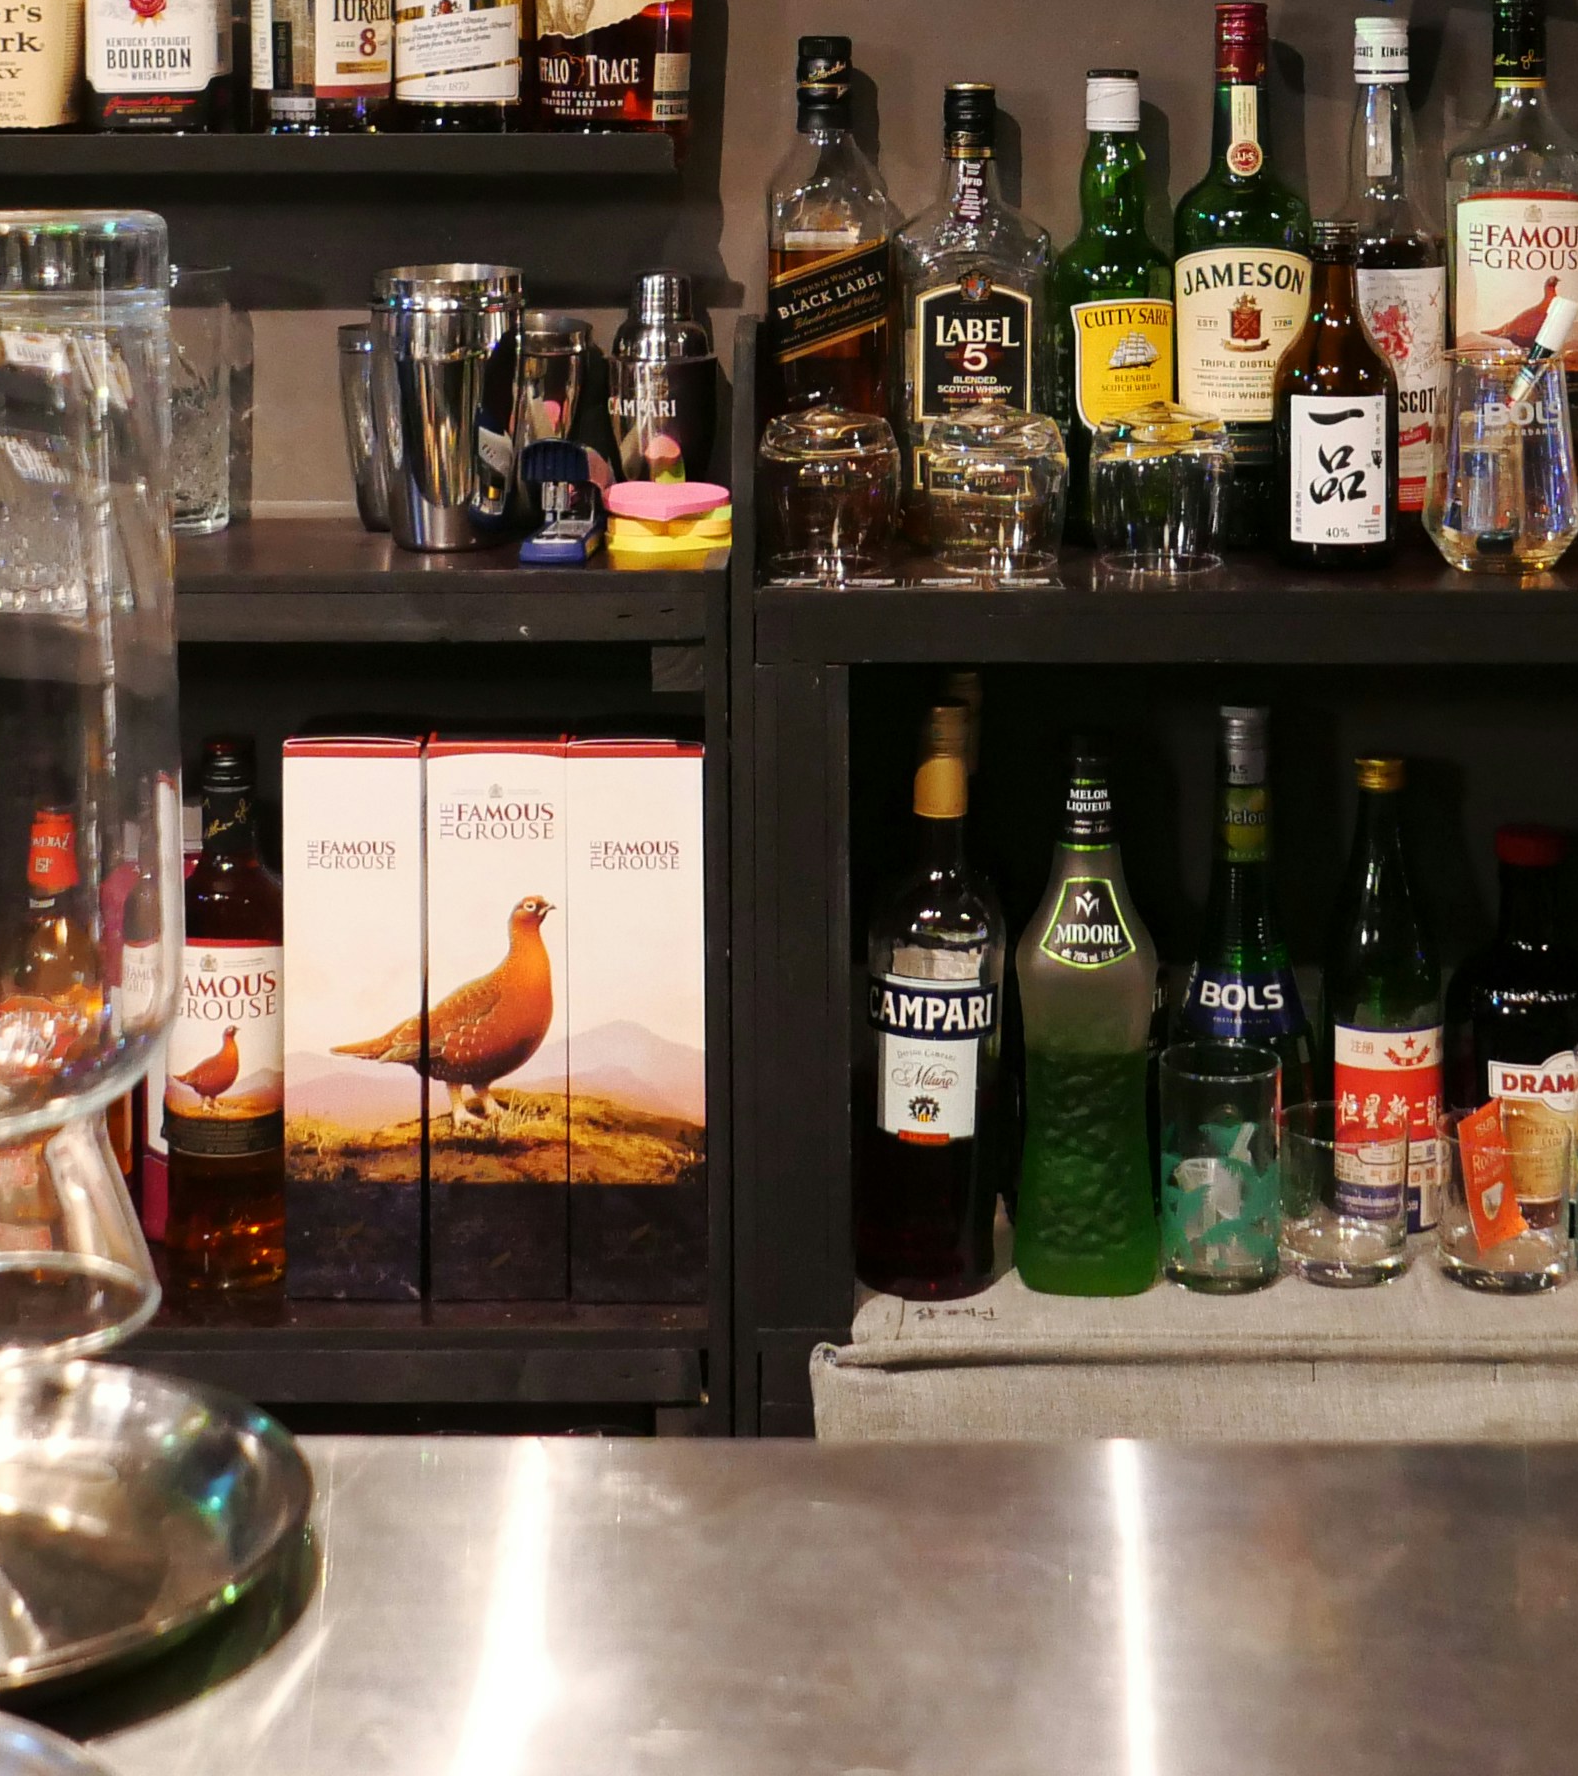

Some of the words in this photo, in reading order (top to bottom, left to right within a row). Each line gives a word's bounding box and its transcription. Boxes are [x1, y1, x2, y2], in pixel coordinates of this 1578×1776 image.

[106, 37, 148, 47] KENTUCKY
[150, 36, 192, 47] STRAIGHT
[359, 28, 377, 57] 8
[106, 48, 192, 69] BOURBON
[131, 71, 169, 81] WHISKEY
[586, 55, 640, 87] TRACE
[551, 90, 597, 99] KENTUCKY
[554, 108, 594, 116] WHISKEY
[576, 100, 624, 108] BOURBON
[1468, 223, 1484, 266] THE
[830, 265, 864, 287] WALKER
[1183, 261, 1306, 296] JAMESON
[777, 289, 837, 320] BLACK
[836, 271, 886, 298] LABEL
[1083, 309, 1134, 329] CUTTY
[1137, 308, 1170, 329] SARK
[935, 315, 1021, 347] LABEL
[962, 343, 989, 372] 5
[1200, 359, 1236, 368] TRIPLE
[952, 375, 998, 384] BLENDED
[1114, 374, 1152, 383] BLENDED
[937, 384, 974, 394] SCOTCH
[974, 384, 1013, 394] WHISKY
[1207, 391, 1236, 400] IRISH
[606, 397, 677, 420] CAMPARI
[1325, 527, 1351, 539] 40%
[1069, 788, 1108, 800] MELON
[1066, 800, 1112, 812] LIQUEUR
[440, 803, 455, 839] THE
[457, 802, 555, 822] FAMOUS
[456, 821, 555, 840] GROUSE
[321, 840, 397, 855] FAMOUS
[603, 840, 680, 855] FAMOUS
[319, 855, 397, 870] GROUSE
[603, 855, 681, 870] GROUSE
[1055, 924, 1122, 946] MIDORI
[182, 969, 277, 998] AMOUS
[1199, 981, 1284, 1011] BOLS
[868, 989, 994, 1031] CAMPARI
